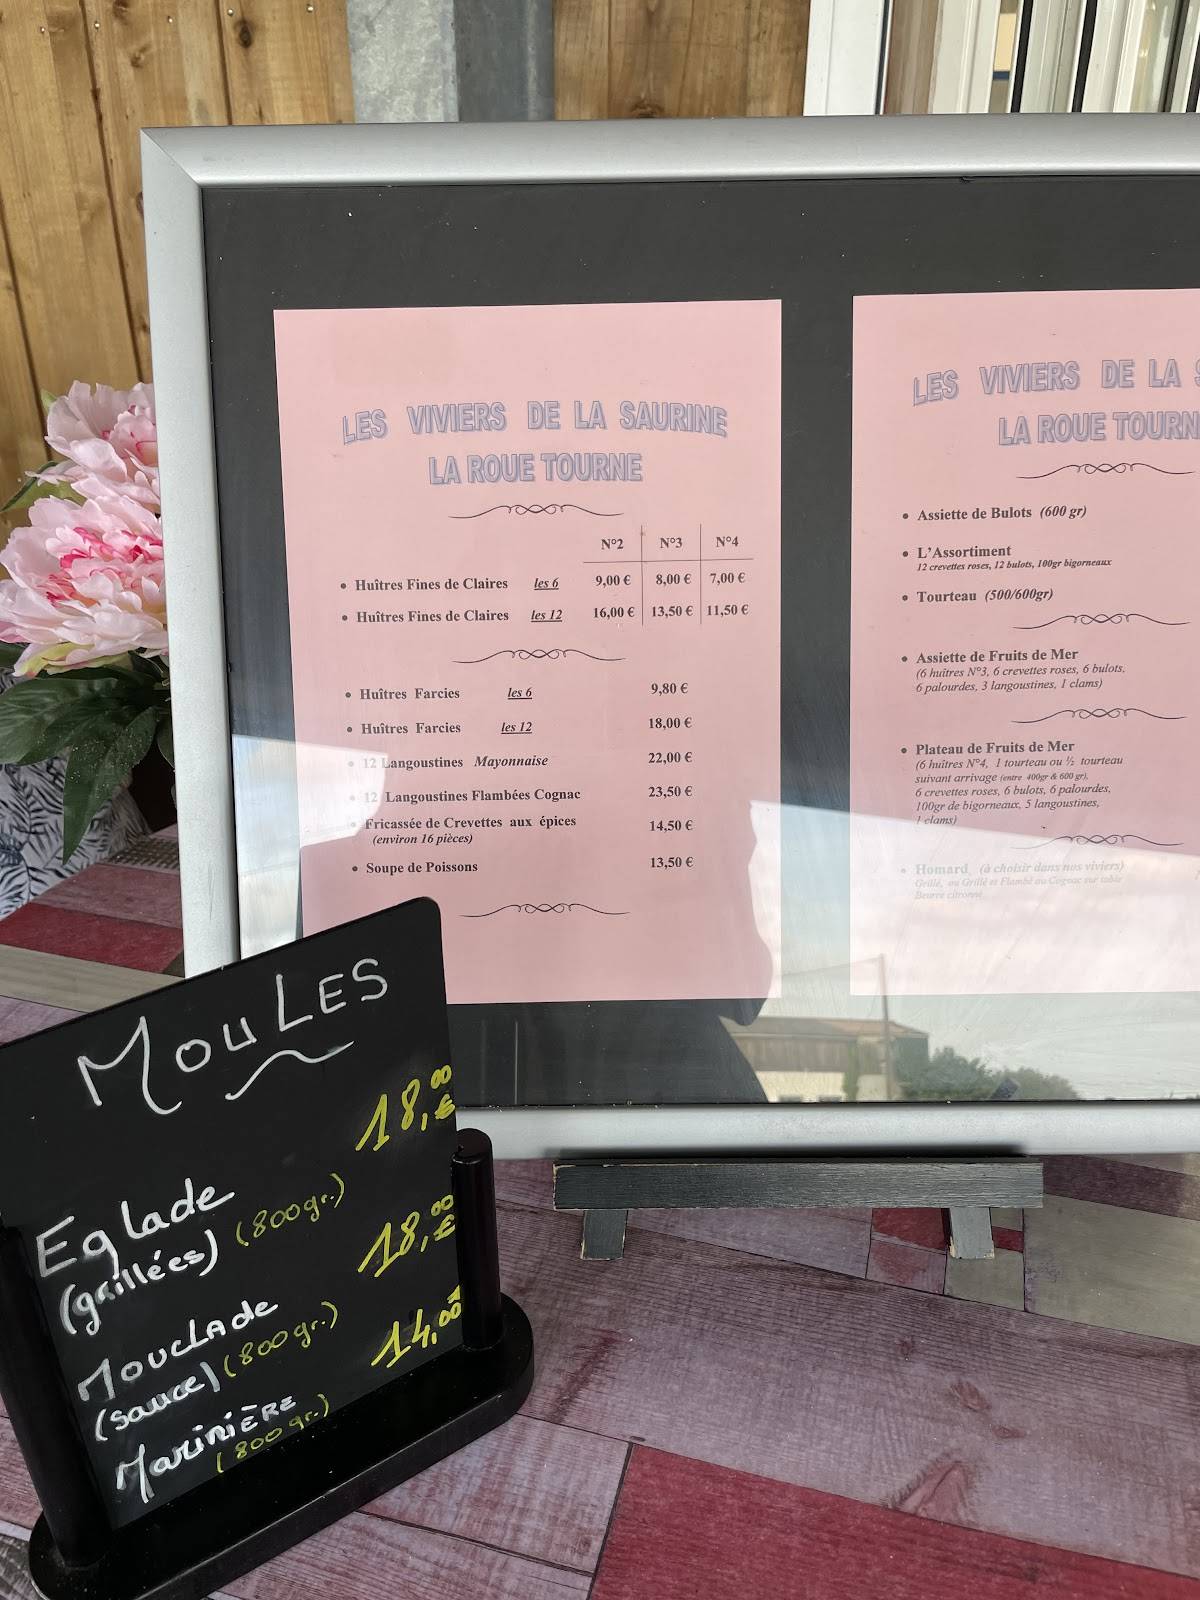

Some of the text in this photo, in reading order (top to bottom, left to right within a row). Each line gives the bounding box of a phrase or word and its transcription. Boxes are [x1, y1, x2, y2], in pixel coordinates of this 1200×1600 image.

[913, 370, 959, 406] LES
[979, 361, 1080, 394] VIVIERS
[1101, 359, 1134, 389] DE
[1148, 359, 1180, 388] LA
[342, 400, 728, 444] LES VIVIERS DE LA SAURINE
[999, 411, 1200, 445] LA ROUE TOURN
[429, 453, 642, 485] LA ROUE TOURNE
[917, 505, 1087, 520] Assiette de Bulots (600 gr)
[601, 535, 738, 550] N°2 N°3 N°4
[917, 559, 1112, 571] 12 crevettes roses, 12 bulots, 100gr bigorneaux
[355, 572, 745, 591] Huîtres Fines de Claires les 6 9,00 € 8,00 € 7,00 €
[917, 589, 1053, 602] Tourteau (500/600gr)
[356, 604, 749, 623] Huîtres Fines de Claires les 12 16,00 € 13,50 € 11,50 €
[916, 649, 1078, 664] Assiette de Fruits de Mer
[916, 664, 1089, 679] (6 6 crevettes roses, 6
[359, 682, 688, 700] Huîtres Farcies les 6 9,80 €
[916, 678, 1102, 693] 6 palourdes, 3 langoustines, clams)
[361, 717, 692, 735] Huîtres Farcies les 12 18,00 €
[916, 741, 1074, 755] Plateau de Fruits de Mer
[363, 751, 692, 773] 12 Langoustines Mayonnaise 22,00 €
[915, 760, 925, 770] (6
[1004, 758, 1046, 767] tourteau
[1081, 756, 1123, 766] tourteau
[915, 773, 951, 783] suivant
[954, 772, 997, 784] arrivage
[1000, 773, 1022, 782] (entre
[1026, 773, 1048, 782] 400gr
[1059, 772, 1074, 780] 600
[364, 785, 692, 806] 12 Langoustines Flambées Cognac 23,50 €
[915, 784, 1056, 797] 6 crevettes roses, 6 bulots, 6
[916, 798, 1099, 812] 100gr de 5 langoustines,
[365, 816, 692, 833] Fricassée de Crevettes aux épices 14,50 €
[372, 833, 473, 846] (environ 16 pièces)
[366, 856, 693, 875] Soupe de Poissons 13,50 €
[95, 1361, 220, 1441] (sauce)
